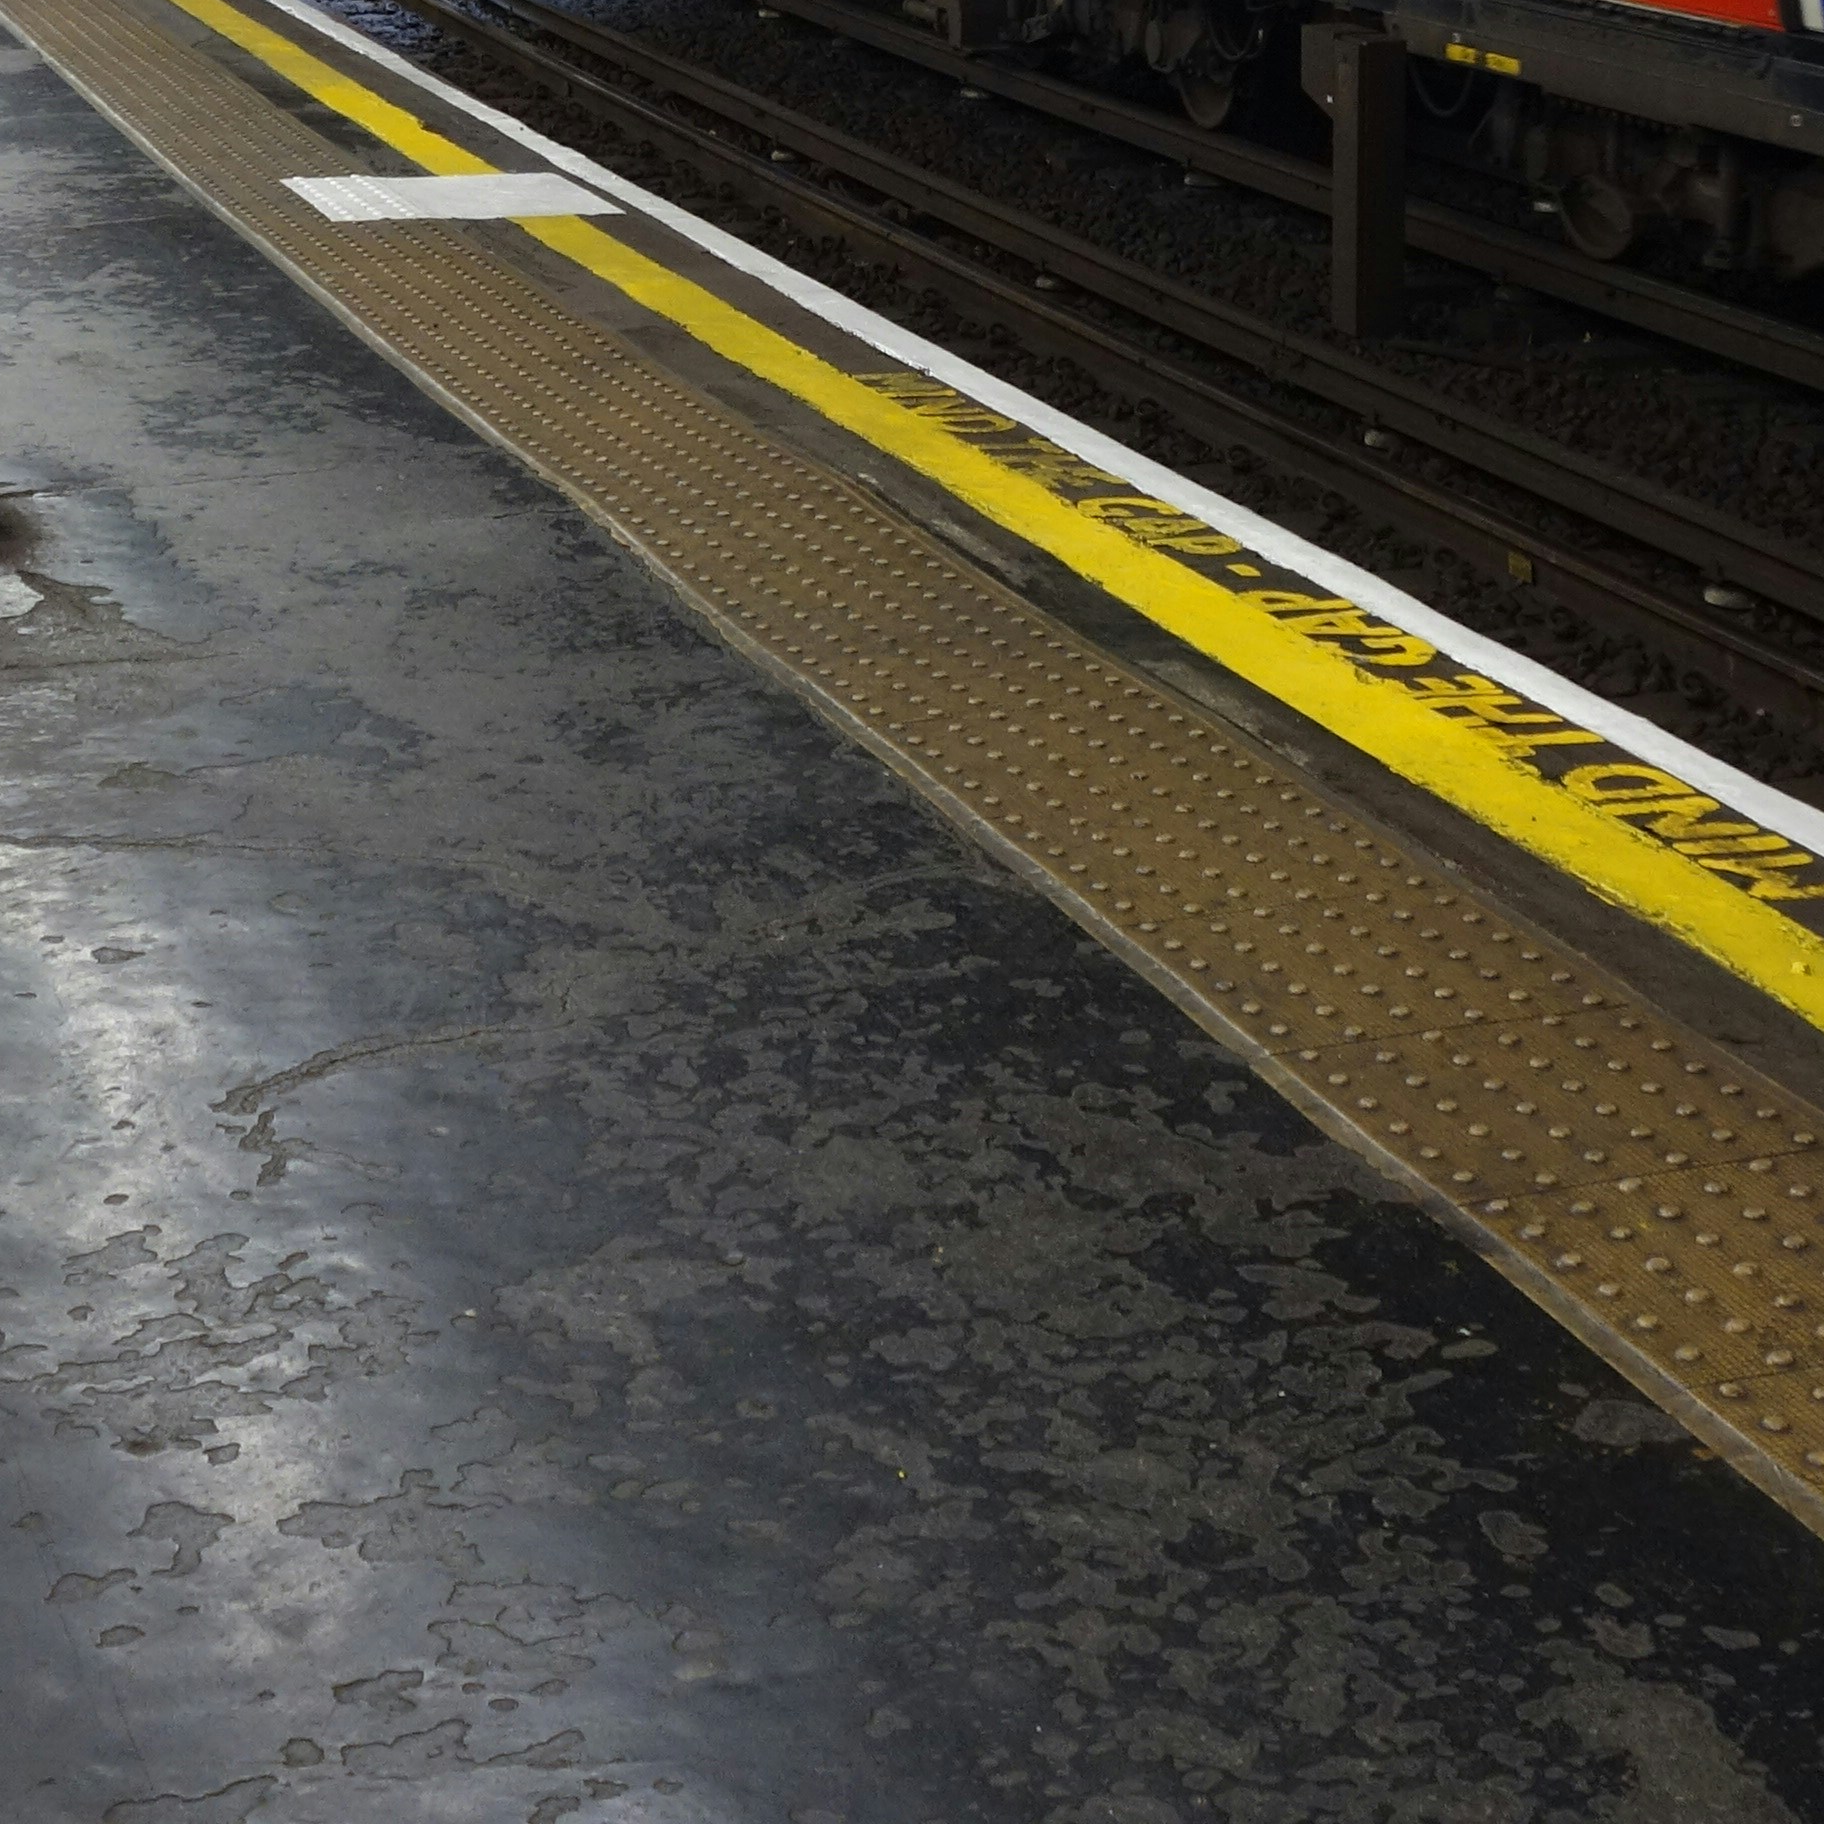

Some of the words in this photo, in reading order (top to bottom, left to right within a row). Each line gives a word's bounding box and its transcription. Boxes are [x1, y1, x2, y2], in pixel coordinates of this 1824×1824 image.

[848, 372, 1018, 434] MIND
[976, 437, 1131, 492] THE
[1075, 496, 1244, 556] GAP
[1232, 588, 1441, 668] GAP
[1396, 674, 1608, 761] THE
